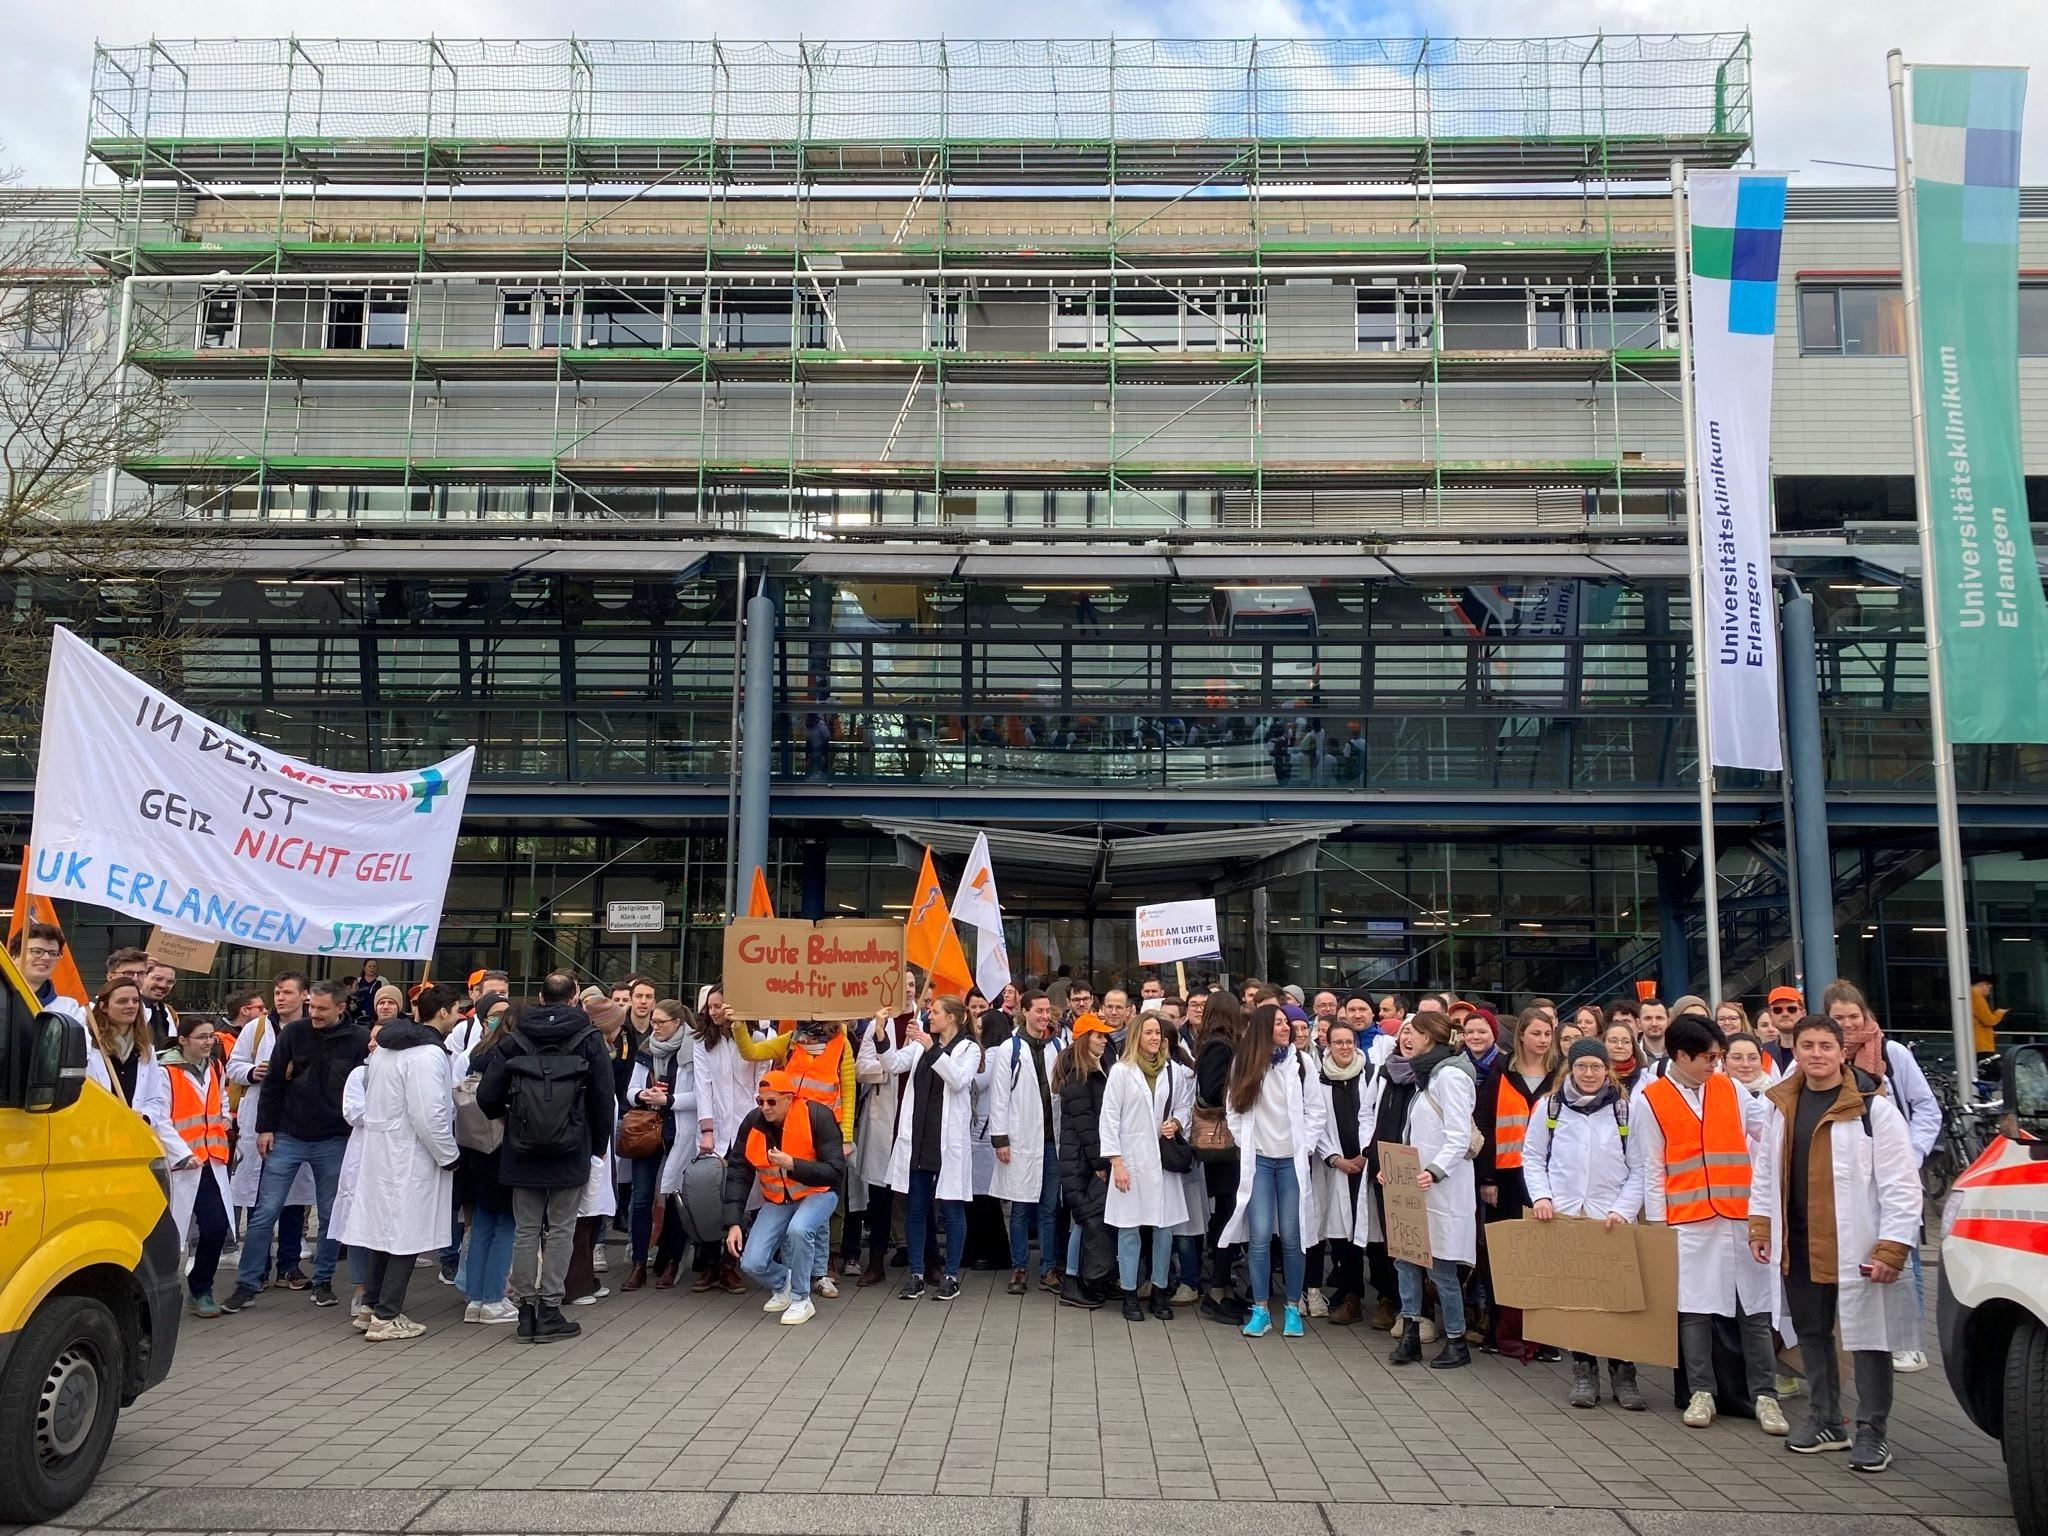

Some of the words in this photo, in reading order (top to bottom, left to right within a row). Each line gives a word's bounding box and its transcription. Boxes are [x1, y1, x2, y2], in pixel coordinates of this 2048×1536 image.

[1940, 345, 1986, 628] Universitätsklinikum
[1709, 420, 1739, 666] Universitätsklinikum
[1991, 506, 2020, 628] Erlangen
[1746, 561, 1763, 667] Erlangen
[136, 696, 184, 742] IN
[199, 726, 268, 772] DER
[139, 789, 216, 836] GEIZ
[242, 785, 308, 826] IST
[234, 827, 351, 878] NICHT
[355, 853, 413, 882] GEIL
[36, 848, 92, 889] UK
[106, 863, 307, 945] ERLANGEN
[318, 922, 430, 953] STREIKT
[738, 934, 799, 965] Gute
[807, 934, 900, 971] Behandlung
[1141, 927, 1164, 938] ÄRZTE
[1166, 927, 1179, 936] AM
[1181, 925, 1204, 935] LIMIT
[1141, 938, 1171, 949] PATIENT
[1173, 937, 1181, 945] IN
[1182, 934, 1215, 945] GEFAHR
[765, 970, 804, 995] auch
[805, 969, 837, 998] für
[842, 979, 869, 998] uns
[1509, 1227, 1591, 1252] FAIRE
[1505, 1252, 1635, 1281] ARBEITS-
[1512, 1276, 1629, 1306] ZEITEN
